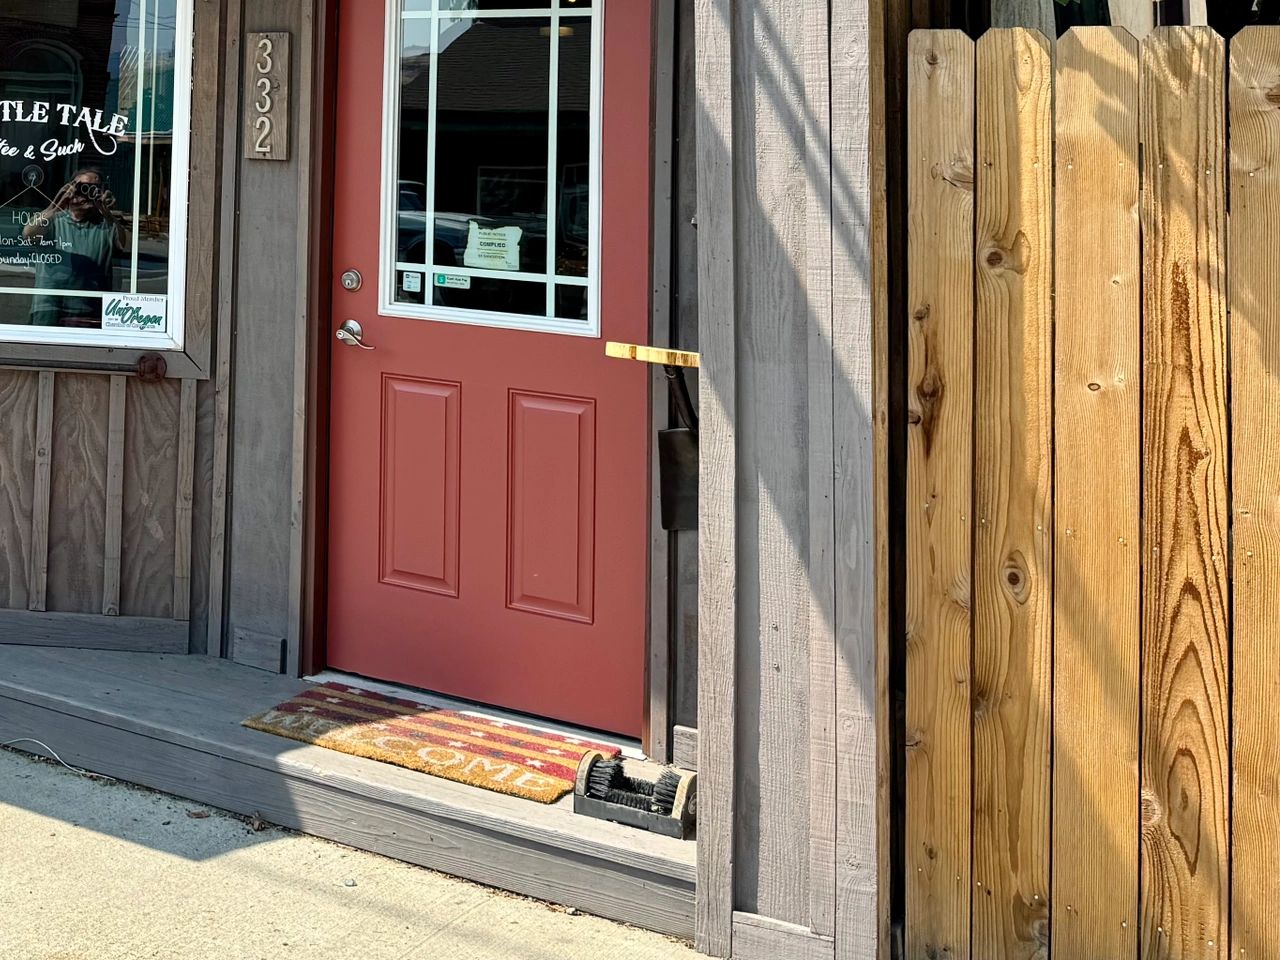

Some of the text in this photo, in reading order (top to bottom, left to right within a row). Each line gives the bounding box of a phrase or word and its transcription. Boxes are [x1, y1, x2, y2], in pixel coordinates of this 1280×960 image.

[255, 38, 272, 153] 332
[57, 104, 129, 155] TALE
[24, 145, 35, 159] &
[40, 139, 85, 161] Such
[12, 210, 49, 227] HOURS
